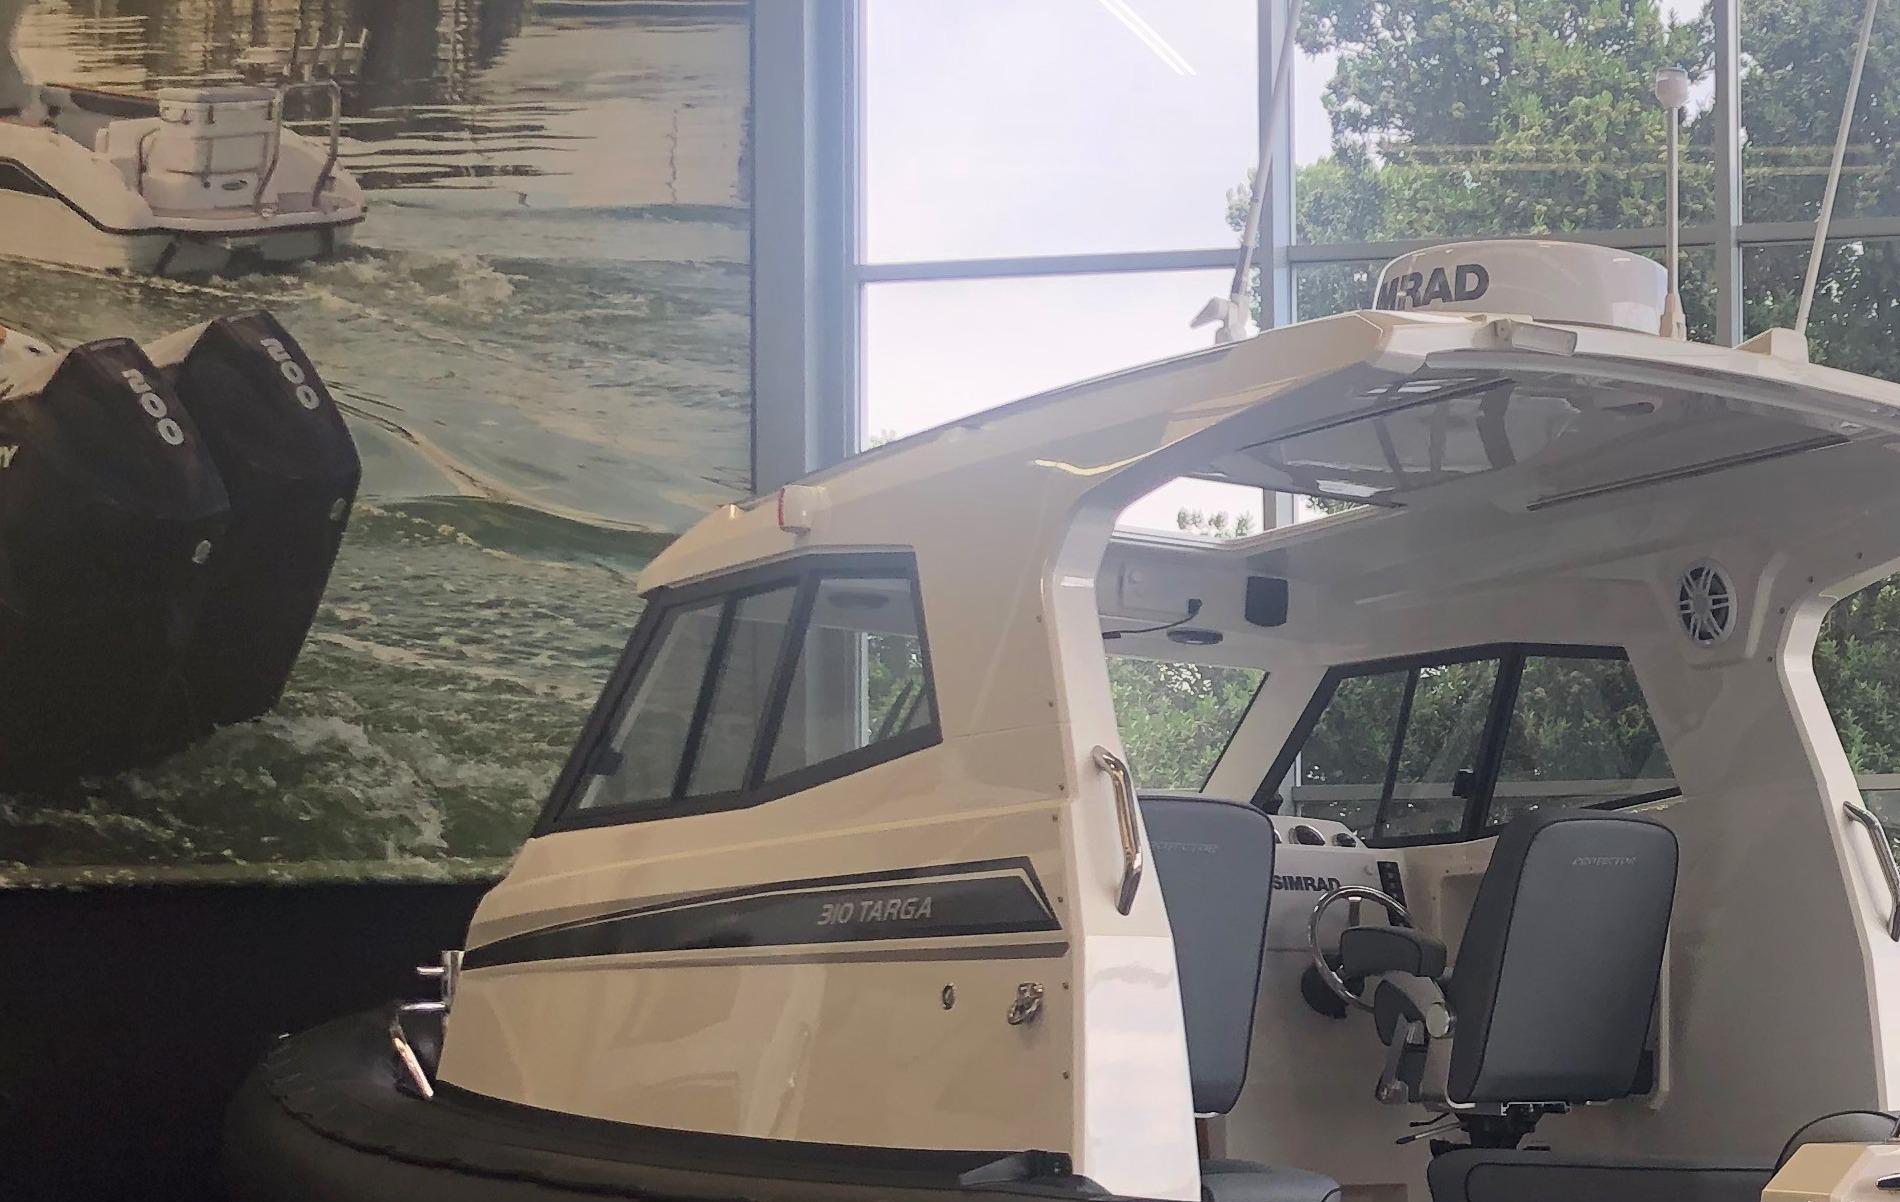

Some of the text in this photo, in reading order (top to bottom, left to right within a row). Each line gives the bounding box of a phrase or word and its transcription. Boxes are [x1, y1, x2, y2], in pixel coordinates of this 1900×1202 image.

[260, 337, 320, 410] 200
[121, 368, 184, 446] 200
[1271, 874, 1342, 892] SIMRAD
[817, 896, 933, 926] 310 TARGA
